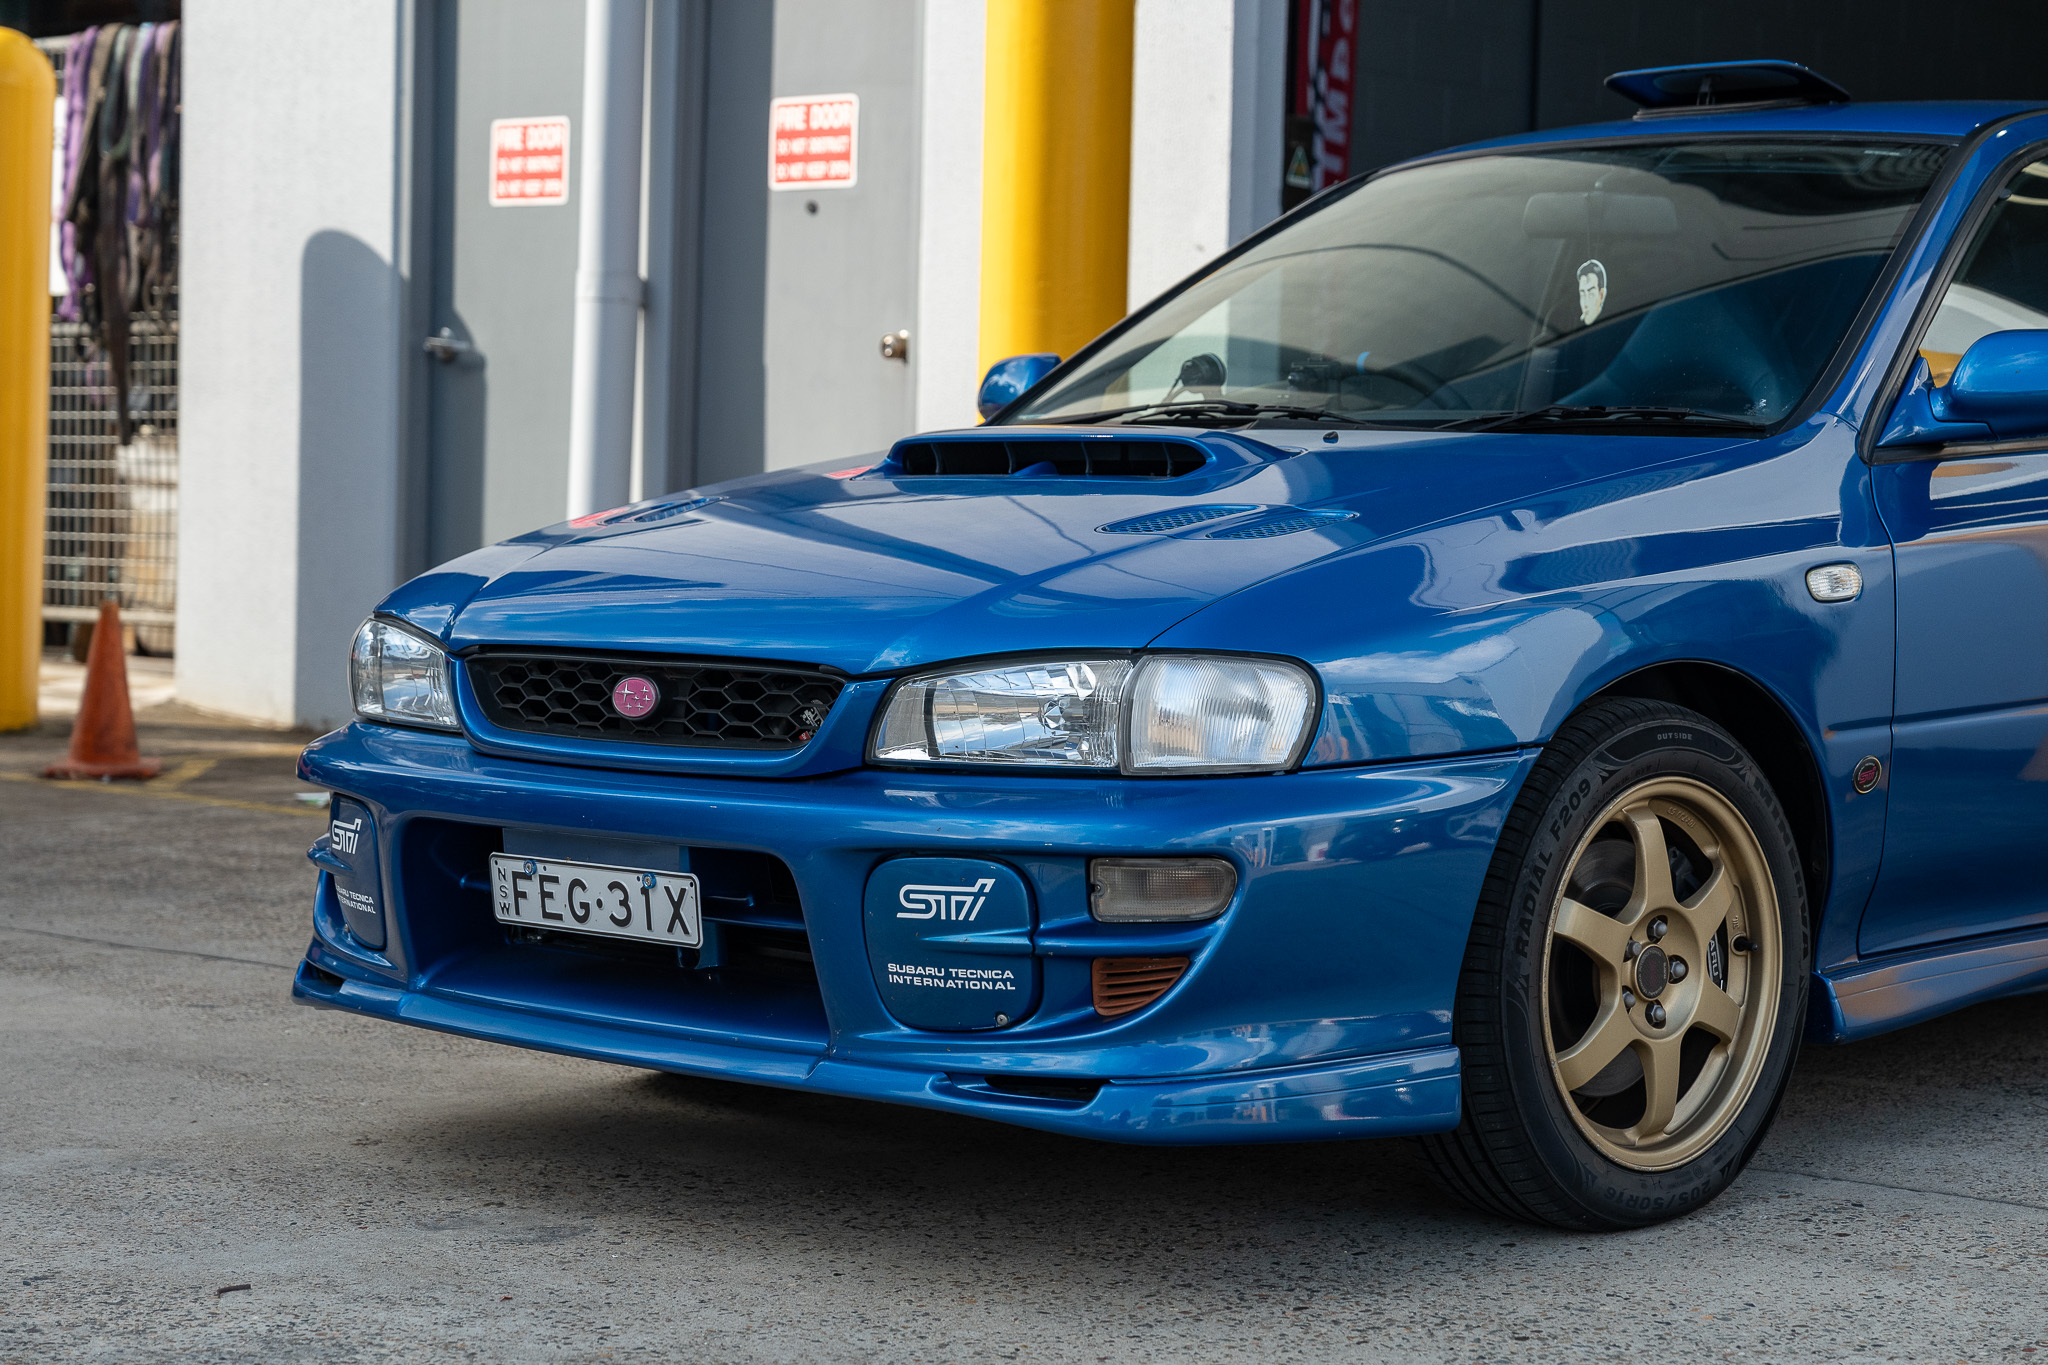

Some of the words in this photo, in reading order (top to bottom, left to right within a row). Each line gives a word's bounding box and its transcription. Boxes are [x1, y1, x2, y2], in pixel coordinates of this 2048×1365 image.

[1657, 732, 1693, 741] OUTSIDE
[1515, 850, 1553, 960] RADIAL
[1549, 777, 1592, 843] F209
[348, 890, 375, 905] TECNICA
[887, 963, 945, 977] SUBARU
[948, 967, 1015, 980] TECNICA
[888, 974, 1016, 991] INTERNATIONAL
[1604, 1180, 1712, 1209] 205/50R16
